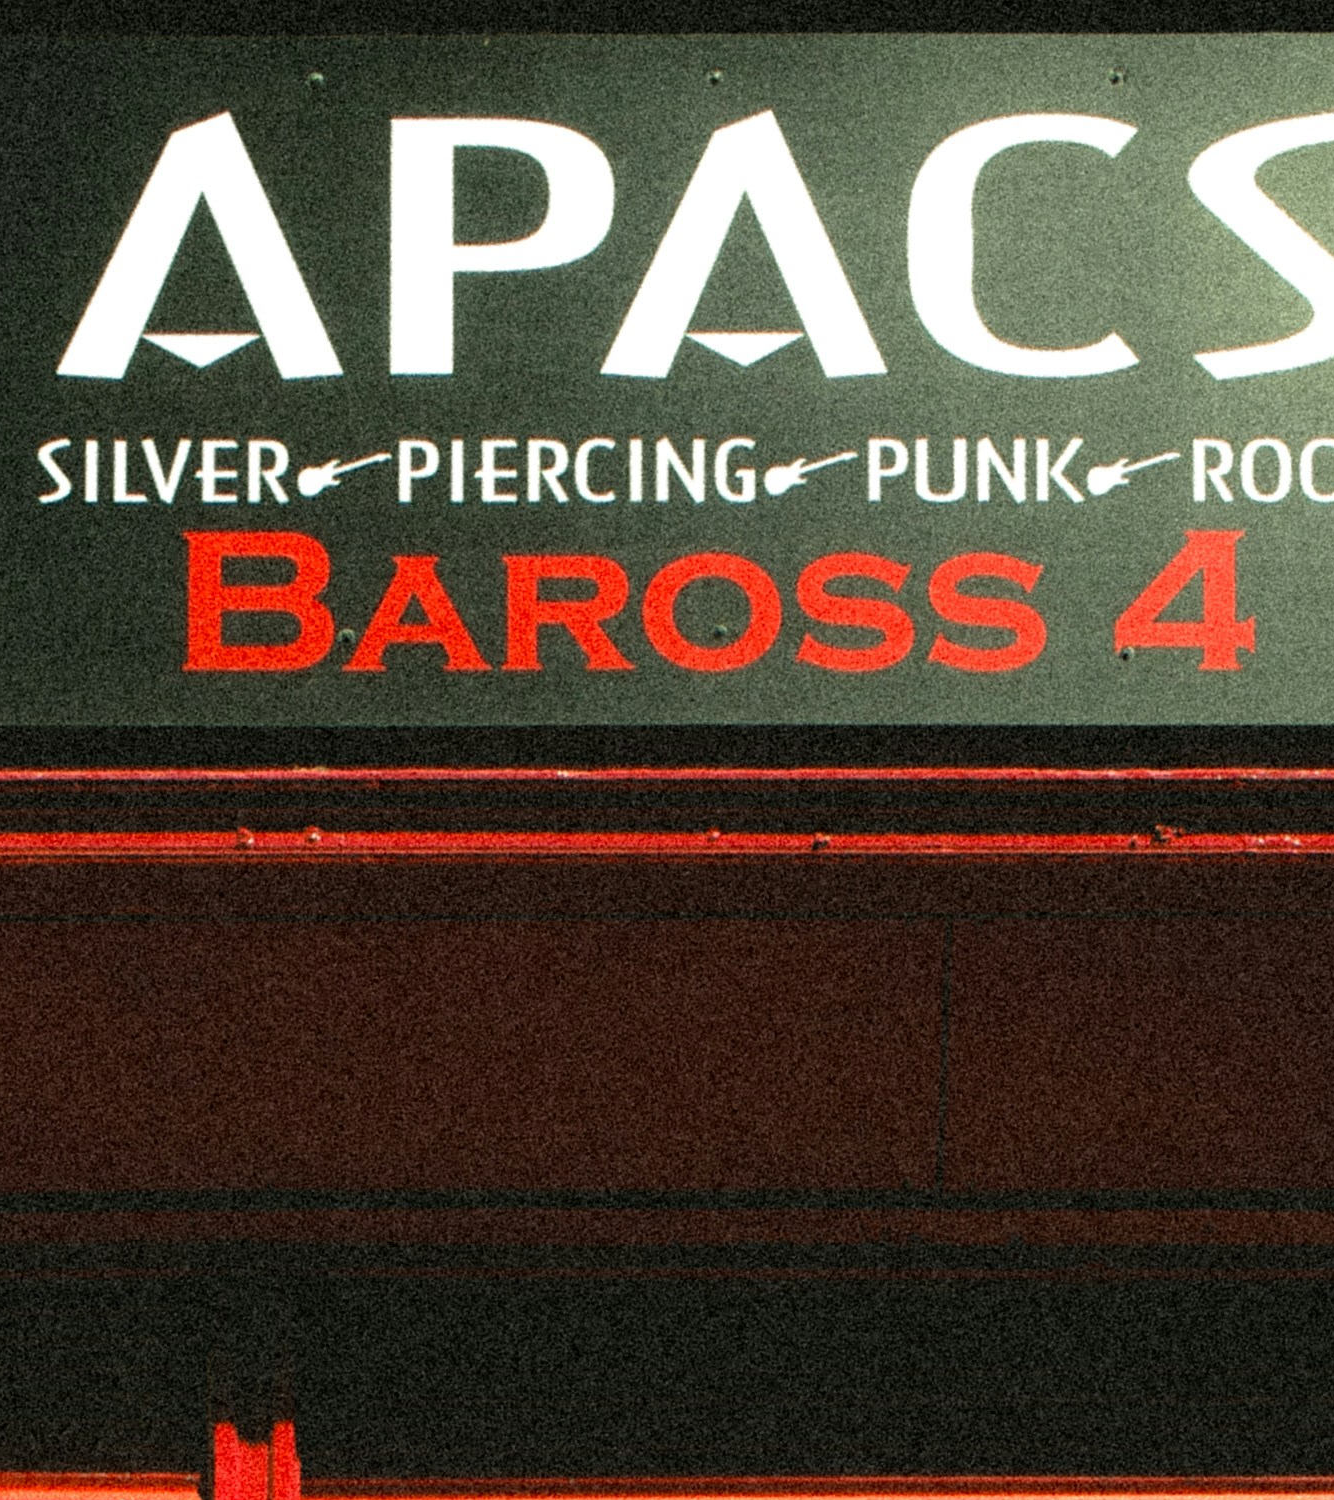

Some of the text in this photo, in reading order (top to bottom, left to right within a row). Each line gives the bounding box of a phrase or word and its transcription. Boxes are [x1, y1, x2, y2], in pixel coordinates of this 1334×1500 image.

[37, 438, 289, 503] SILVER
[398, 438, 757, 503] PIERCING
[867, 438, 1085, 503] PUNK
[1114, 530, 1255, 671] 4
